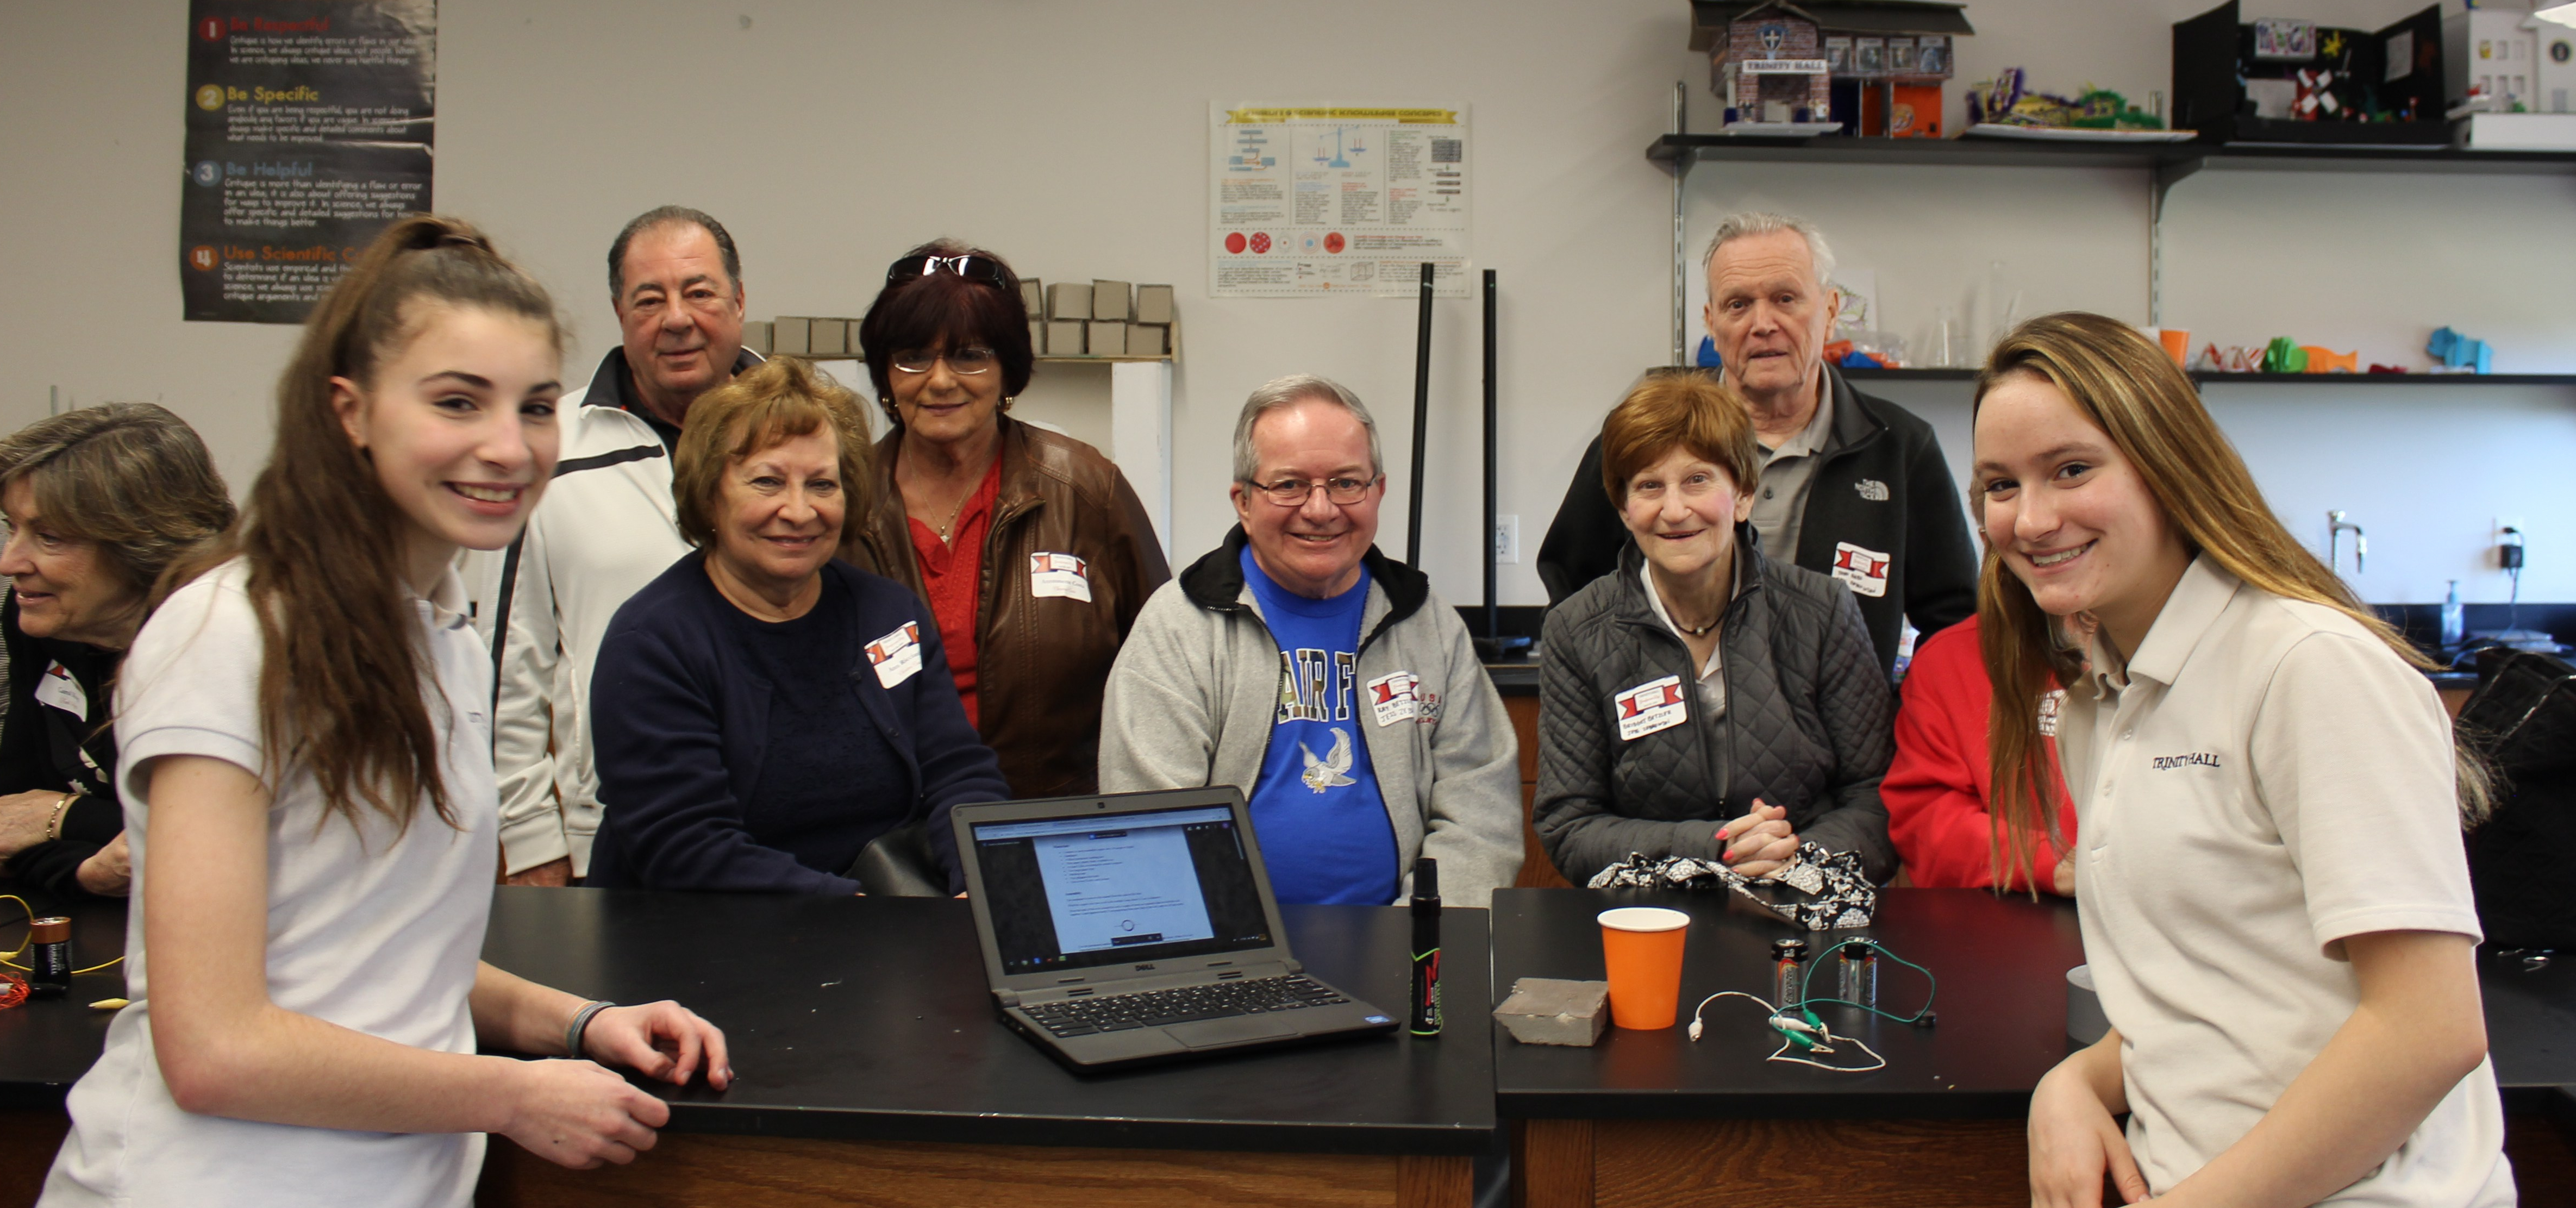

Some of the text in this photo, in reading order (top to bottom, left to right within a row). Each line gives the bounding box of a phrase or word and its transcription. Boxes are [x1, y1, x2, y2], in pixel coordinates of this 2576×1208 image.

[209, 22, 216, 37] 1
[1747, 61, 1824, 70] TRINITY HALL
[203, 90, 217, 106] 2
[227, 85, 318, 104] Be Specific
[201, 164, 214, 181] 3
[226, 162, 313, 178] Be Helpful
[196, 249, 211, 267] 4
[223, 245, 255, 260] Use
[262, 245, 336, 261] Scientific
[1277, 647, 1329, 725] AIR
[1135, 963, 1156, 972] DELL
